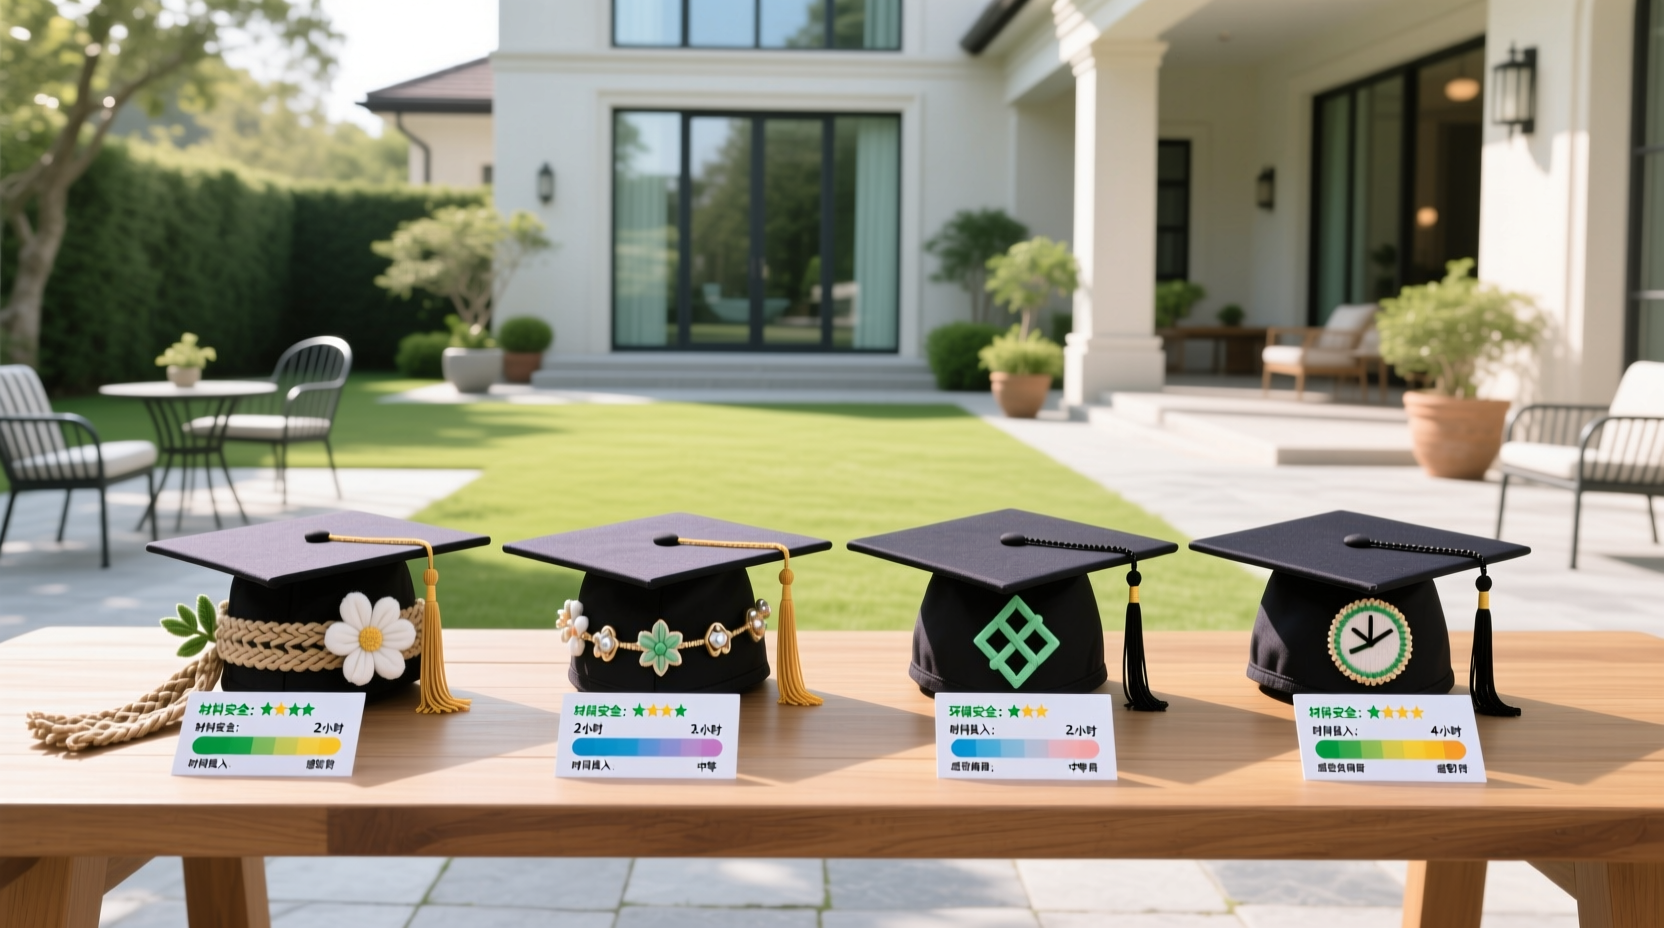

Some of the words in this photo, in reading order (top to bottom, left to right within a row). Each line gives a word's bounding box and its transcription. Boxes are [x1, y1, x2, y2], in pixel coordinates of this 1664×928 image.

[313, 722, 344, 735] 2小时
[573, 722, 603, 735] 2小时
[1065, 724, 1098, 737] 2小时
[1430, 725, 1462, 737] 4小时
